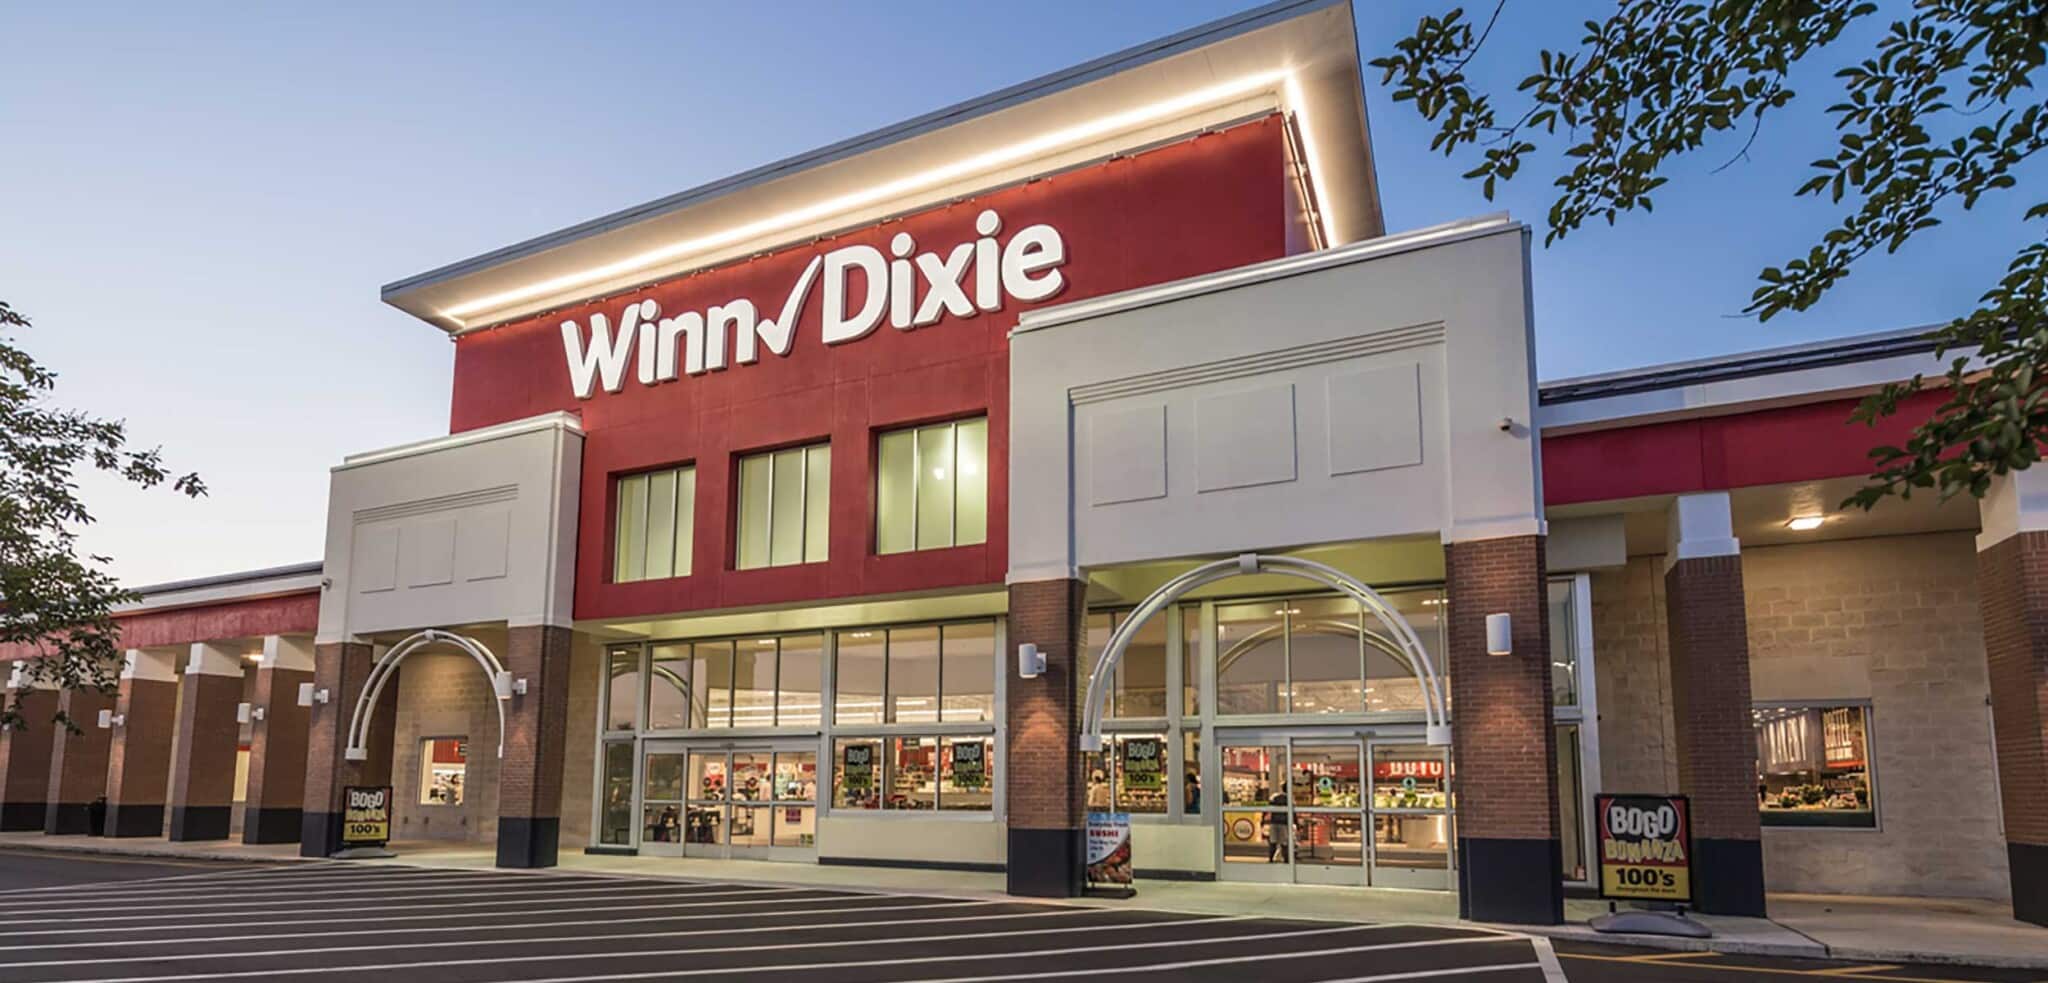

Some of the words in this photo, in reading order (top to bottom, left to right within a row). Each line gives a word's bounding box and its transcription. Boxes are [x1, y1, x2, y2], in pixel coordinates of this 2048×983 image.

[560, 298, 760, 400] Winn
[822, 208, 1067, 346] Dixie
[1128, 742, 1156, 759] BOGO
[351, 791, 384, 809] BOGO
[351, 823, 381, 834] 100's
[1610, 805, 1675, 839] BOGO
[1089, 829, 1119, 837] SUSHI
[1604, 838, 1685, 863] BONANZA
[1615, 868, 1675, 887] 100's
